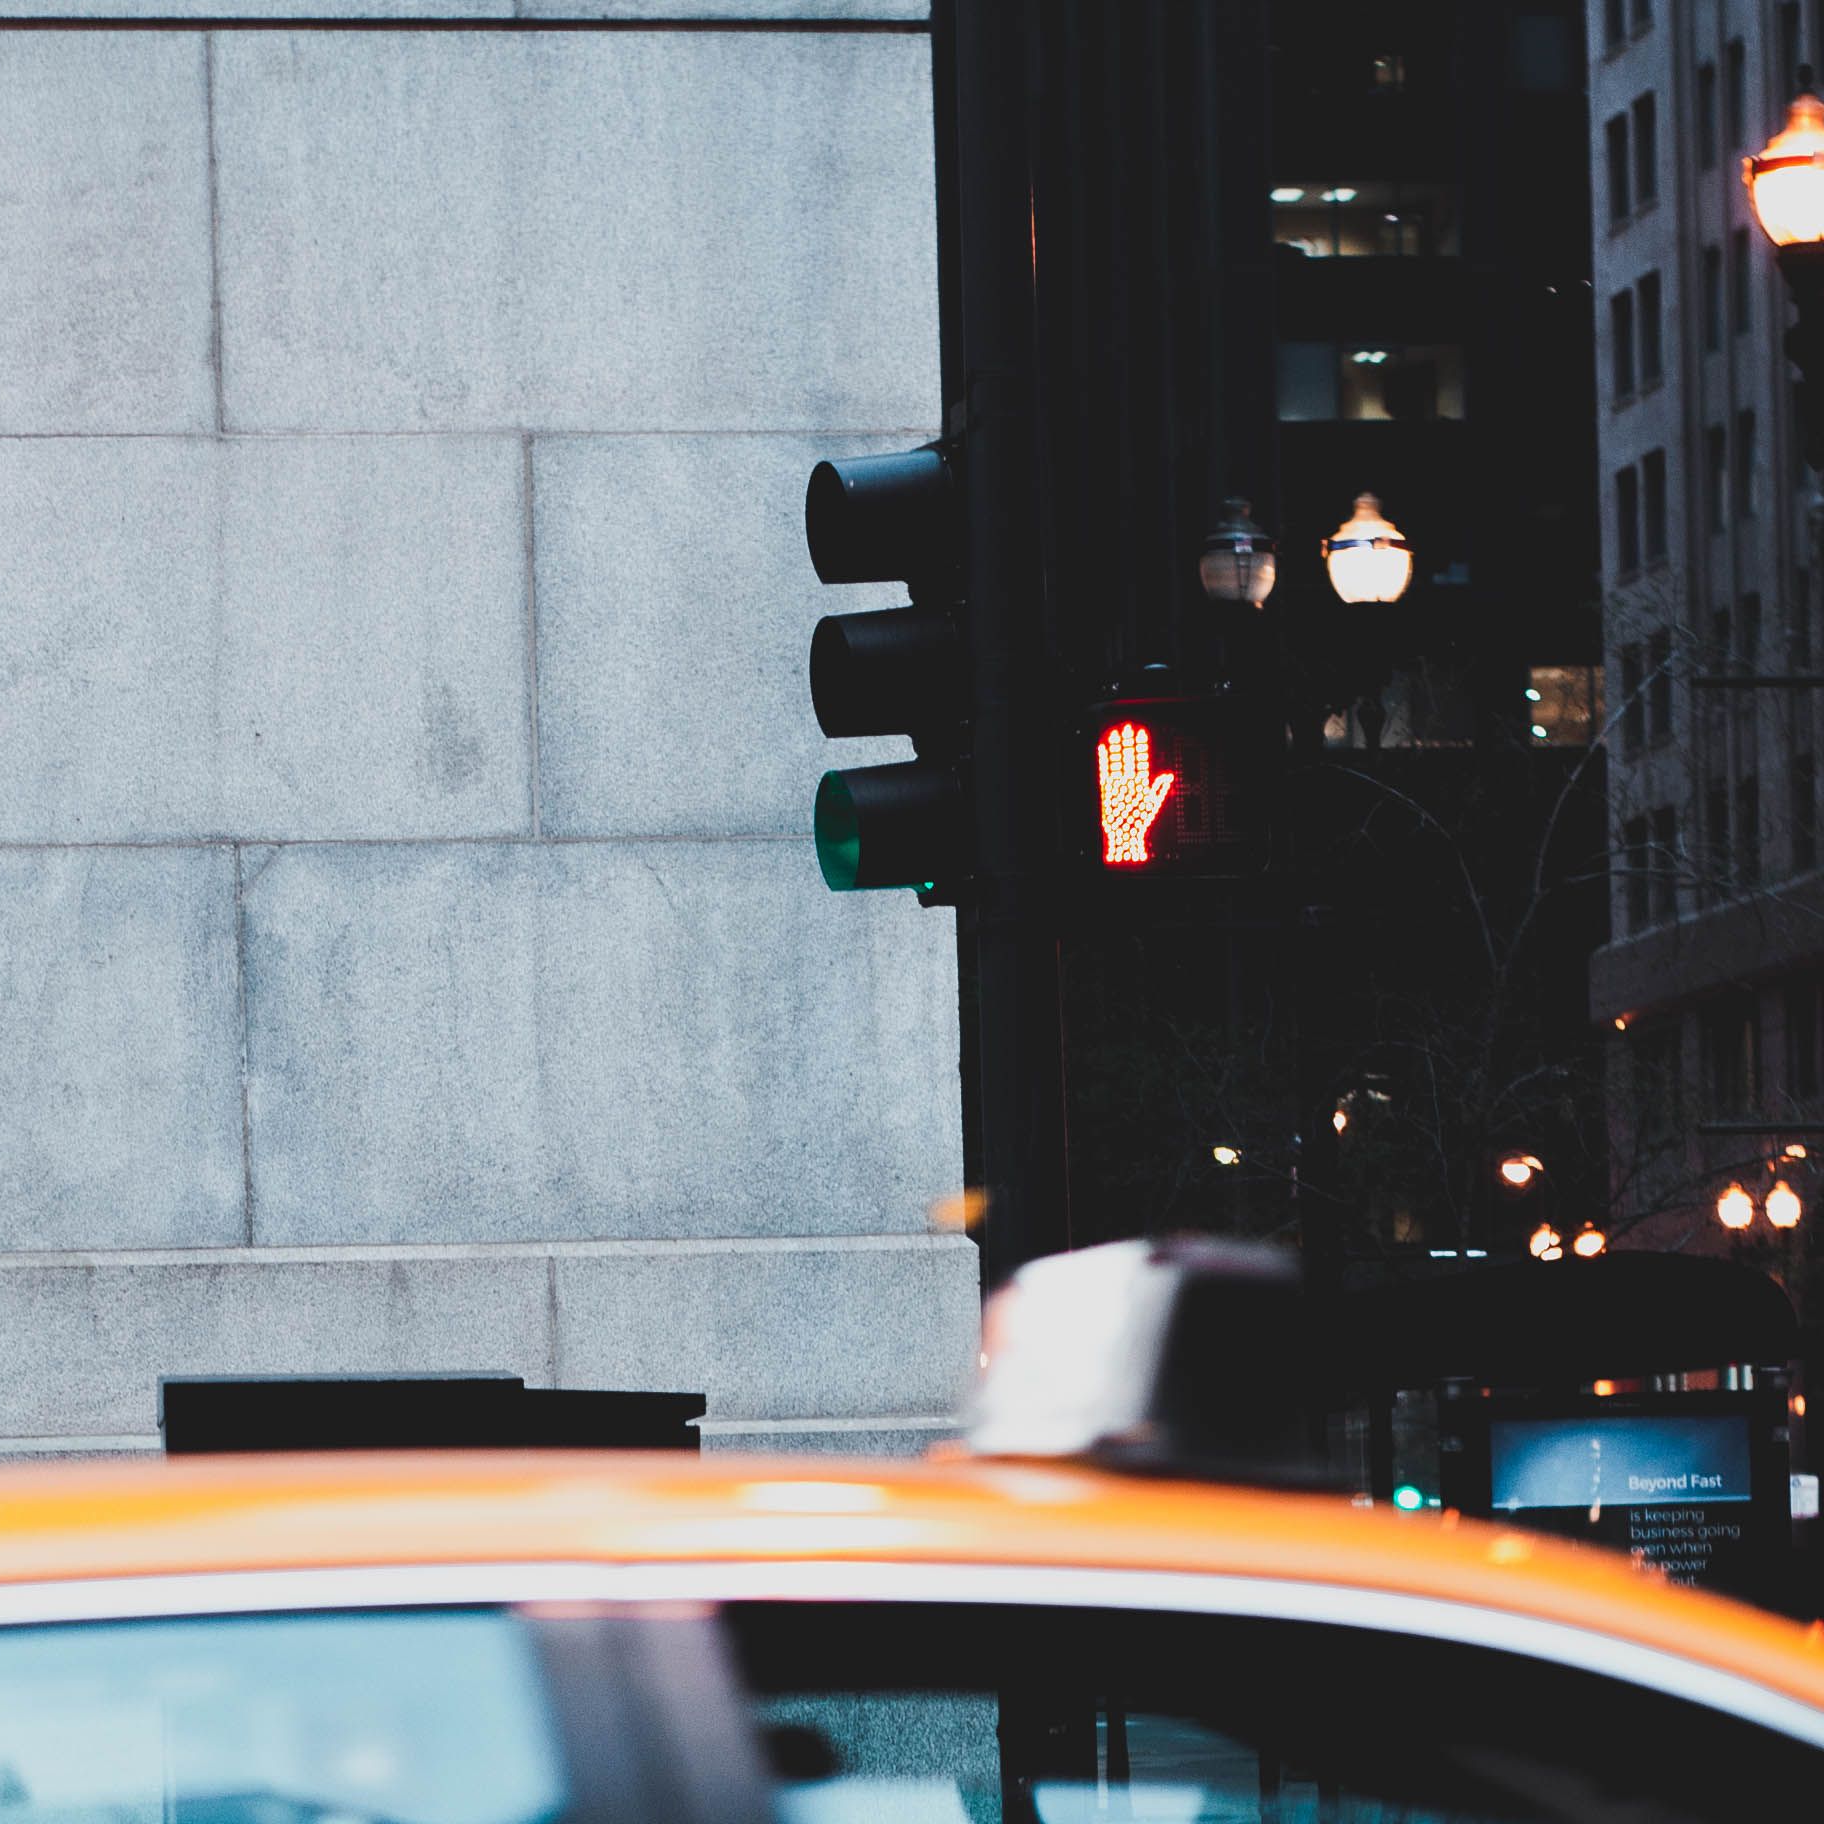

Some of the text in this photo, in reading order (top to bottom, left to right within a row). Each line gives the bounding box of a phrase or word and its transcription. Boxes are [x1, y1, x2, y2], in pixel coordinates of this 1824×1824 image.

[1628, 1473, 1723, 1491] Beyond Fast
[1630, 1508, 1704, 1525] is keeping
[1631, 1523, 1740, 1540] business going
[1630, 1540, 1712, 1556] even when
[1660, 1560, 1705, 1574] power
